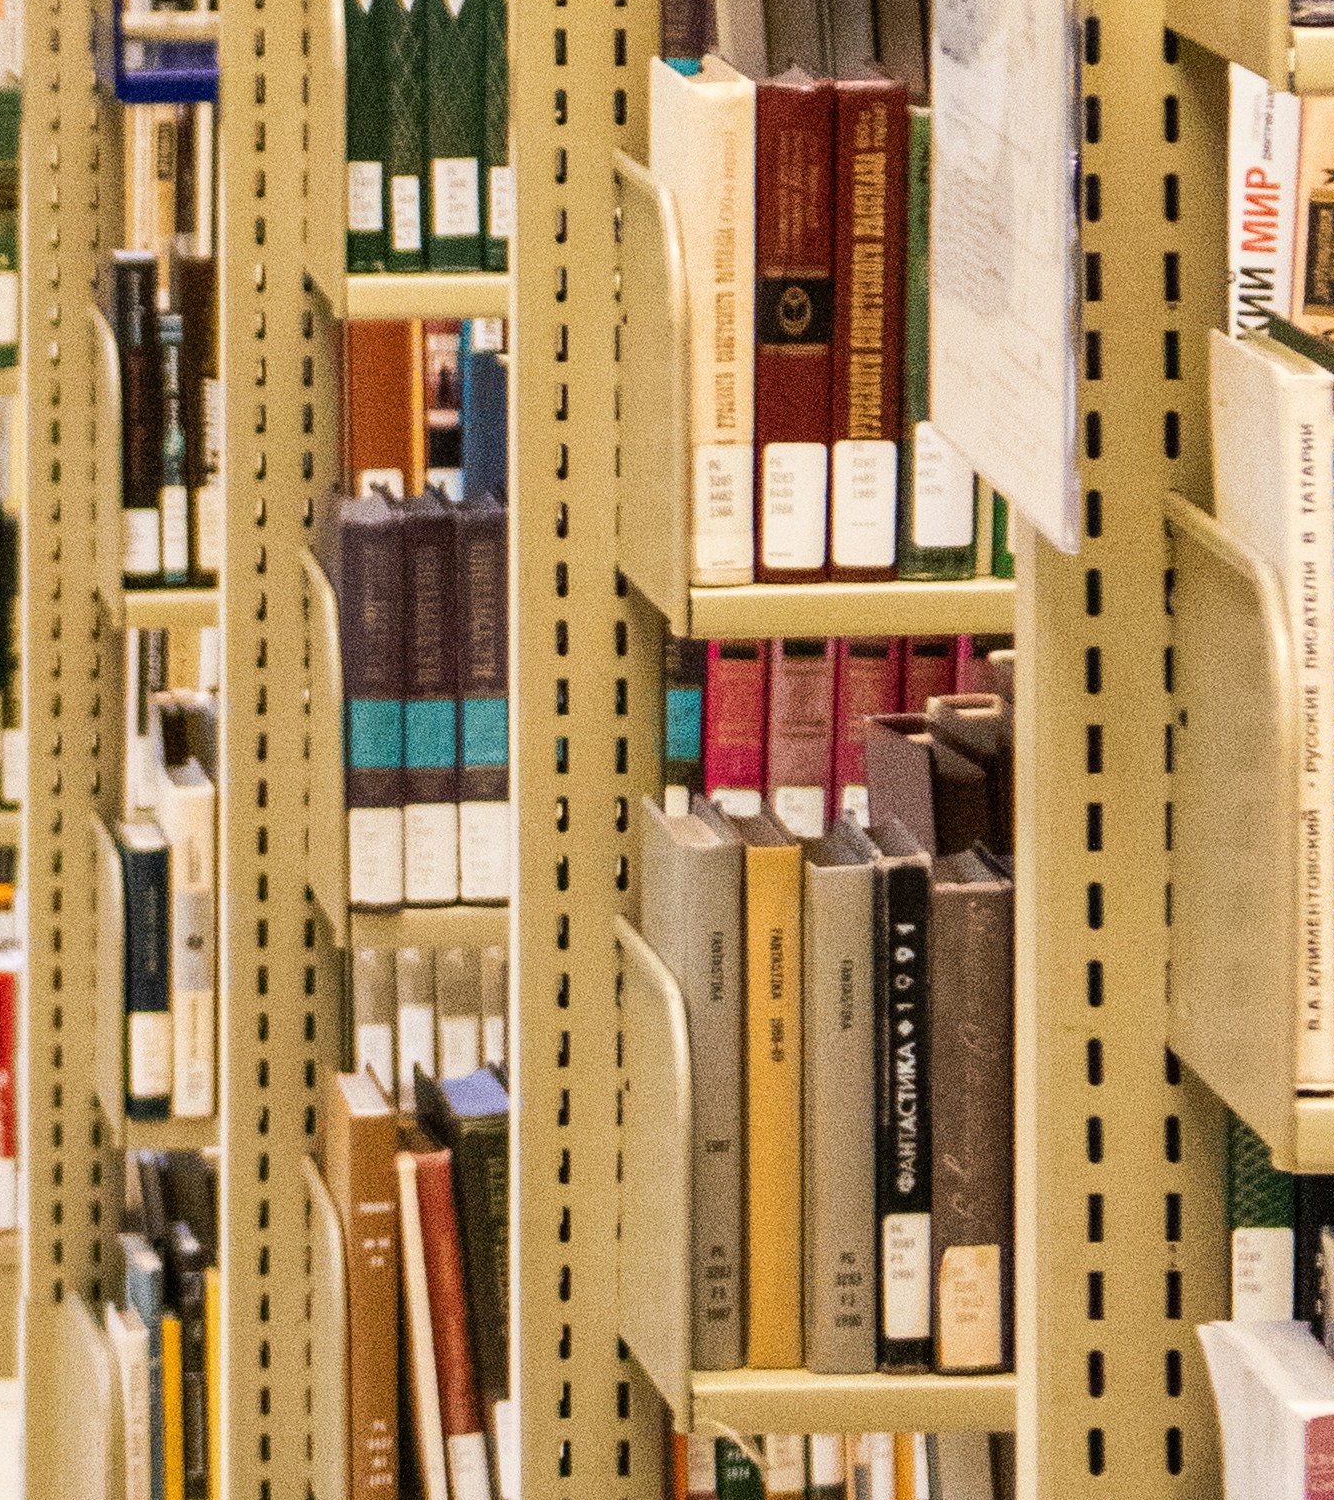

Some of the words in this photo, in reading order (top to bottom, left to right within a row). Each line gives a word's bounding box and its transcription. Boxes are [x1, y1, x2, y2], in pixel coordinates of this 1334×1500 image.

[1239, 165, 1284, 258] МИР
[1298, 420, 1317, 517] ТАТАРИИ
[1299, 560, 1320, 671] ПИСАТЕЛИ
[1300, 684, 1321, 774] РУССКИЕ
[1301, 808, 1324, 989] КЛИМЕНТОВСКИЙ
[894, 1041, 917, 1193] ФАНТАСТИКА
